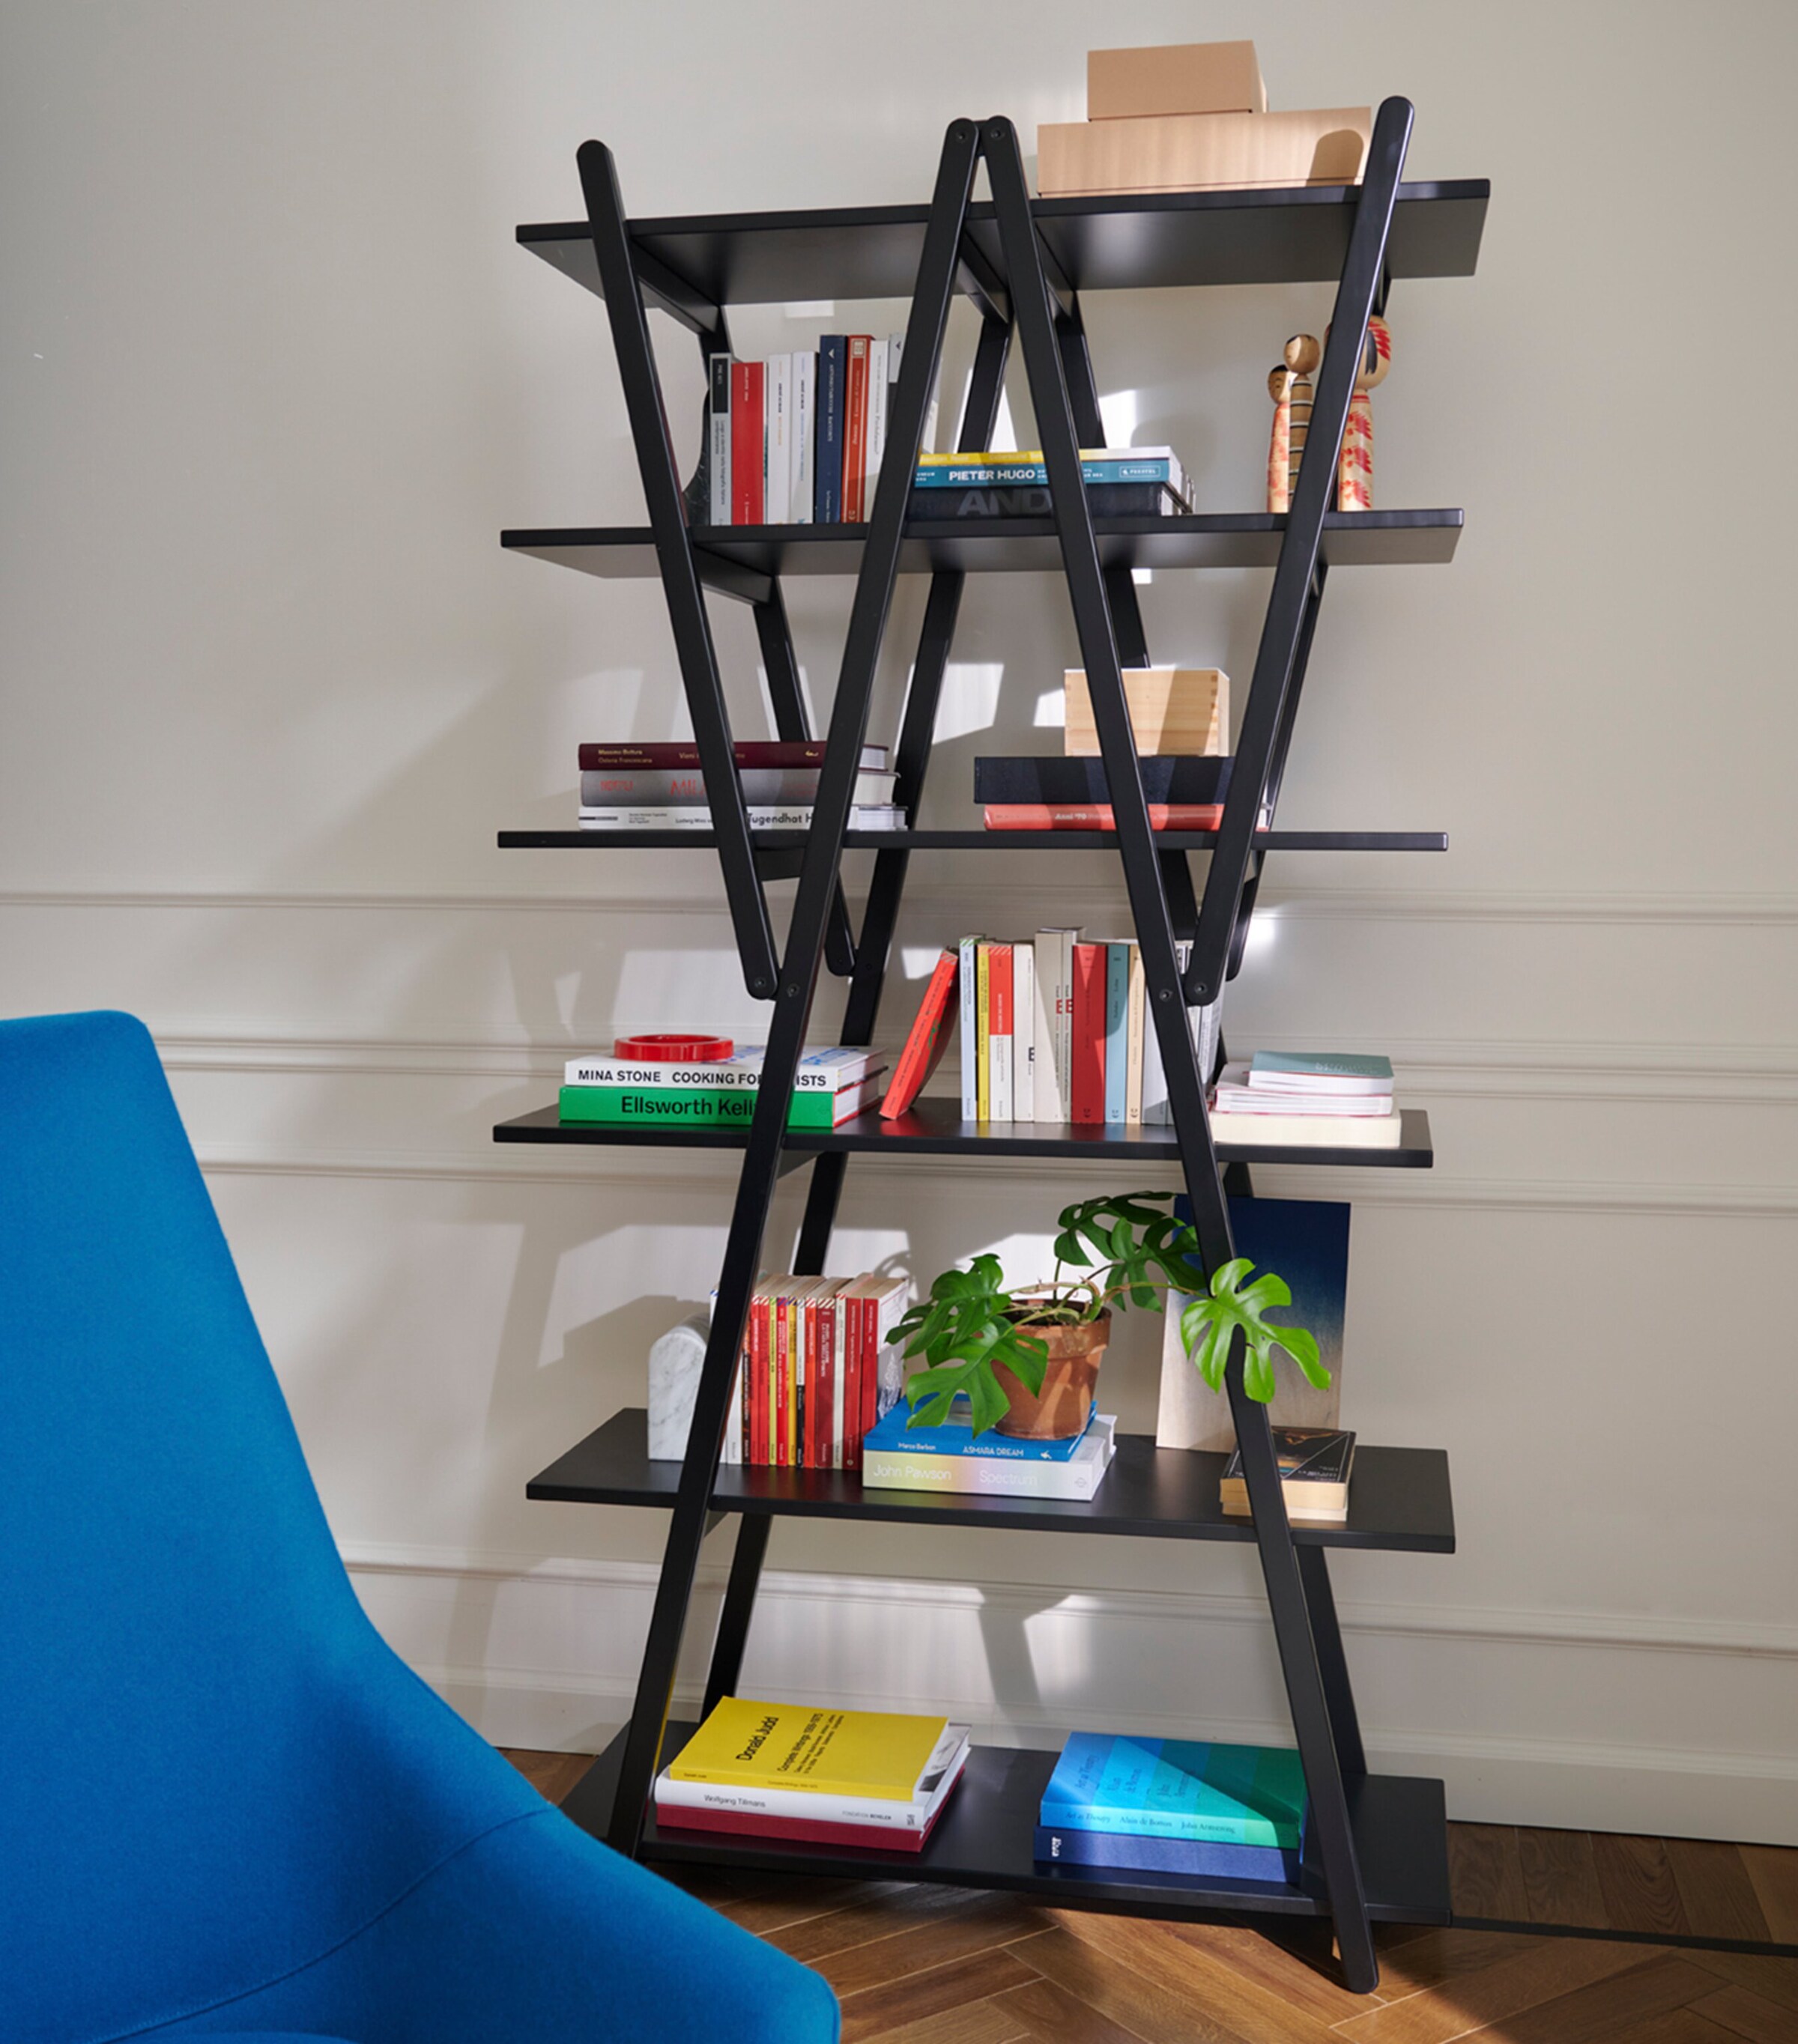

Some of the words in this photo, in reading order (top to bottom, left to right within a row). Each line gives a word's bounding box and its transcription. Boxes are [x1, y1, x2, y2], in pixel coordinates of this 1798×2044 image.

[948, 470, 994, 481] PIETER
[997, 469, 1035, 479] HUGO
[578, 1070, 614, 1082] MINA
[617, 1071, 661, 1082] STONE
[672, 1072, 734, 1085] COOKING
[796, 1075, 826, 1086] ISTS
[621, 1096, 714, 1116] Ellsworth
[718, 1097, 756, 1116] Kell
[963, 1446, 995, 1455] ASMARA
[996, 1447, 1024, 1457] DREAM
[873, 1464, 902, 1477] John
[905, 1467, 951, 1482] Pawson
[979, 1470, 1038, 1486] Spectrum
[735, 1735, 766, 1760] Donald
[756, 1716, 779, 1735] Judd
[777, 1752, 798, 1771] Complete
[703, 1794, 736, 1806] Wolfgang
[738, 1798, 766, 1808] Tillmans
[1086, 1814, 1111, 1824] Therapy
[1119, 1816, 1138, 1825] Alain
[1139, 1817, 1148, 1825] de
[1149, 1819, 1172, 1828] Botton
[1181, 1822, 1197, 1831] John
[1199, 1823, 1235, 1834] Armstrong
